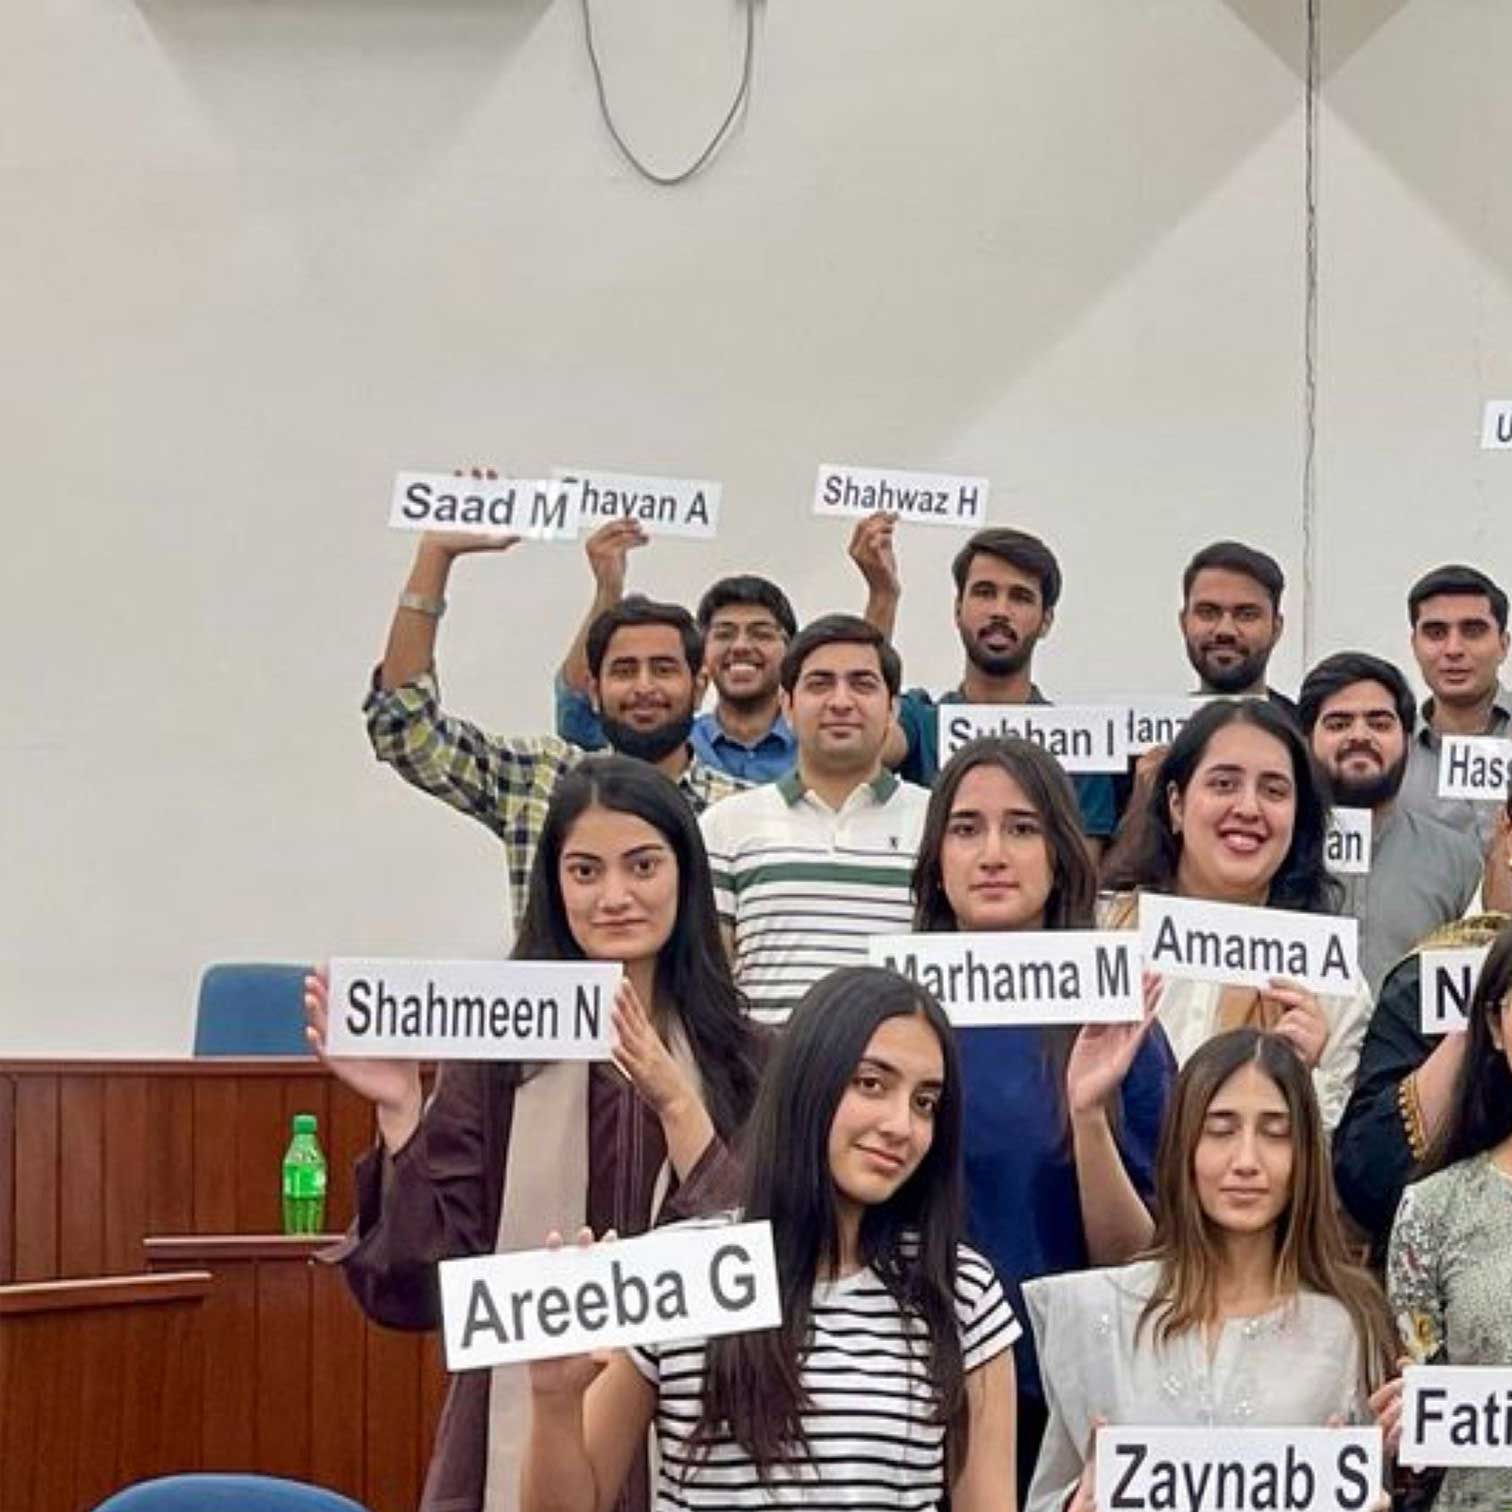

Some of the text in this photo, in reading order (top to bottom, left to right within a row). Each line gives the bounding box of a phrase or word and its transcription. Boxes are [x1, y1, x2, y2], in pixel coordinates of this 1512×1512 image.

[403, 480, 568, 529] Saad M
[561, 475, 709, 525] hayan A
[823, 475, 978, 516] Shahwaz H
[1448, 743, 1509, 789] Has
[1096, 945, 1130, 997] M
[1152, 913, 1350, 980] Amama A
[346, 979, 600, 1039] Shahmeen N
[460, 1244, 757, 1349] Areeba G
[1335, 1444, 1369, 1511] S
